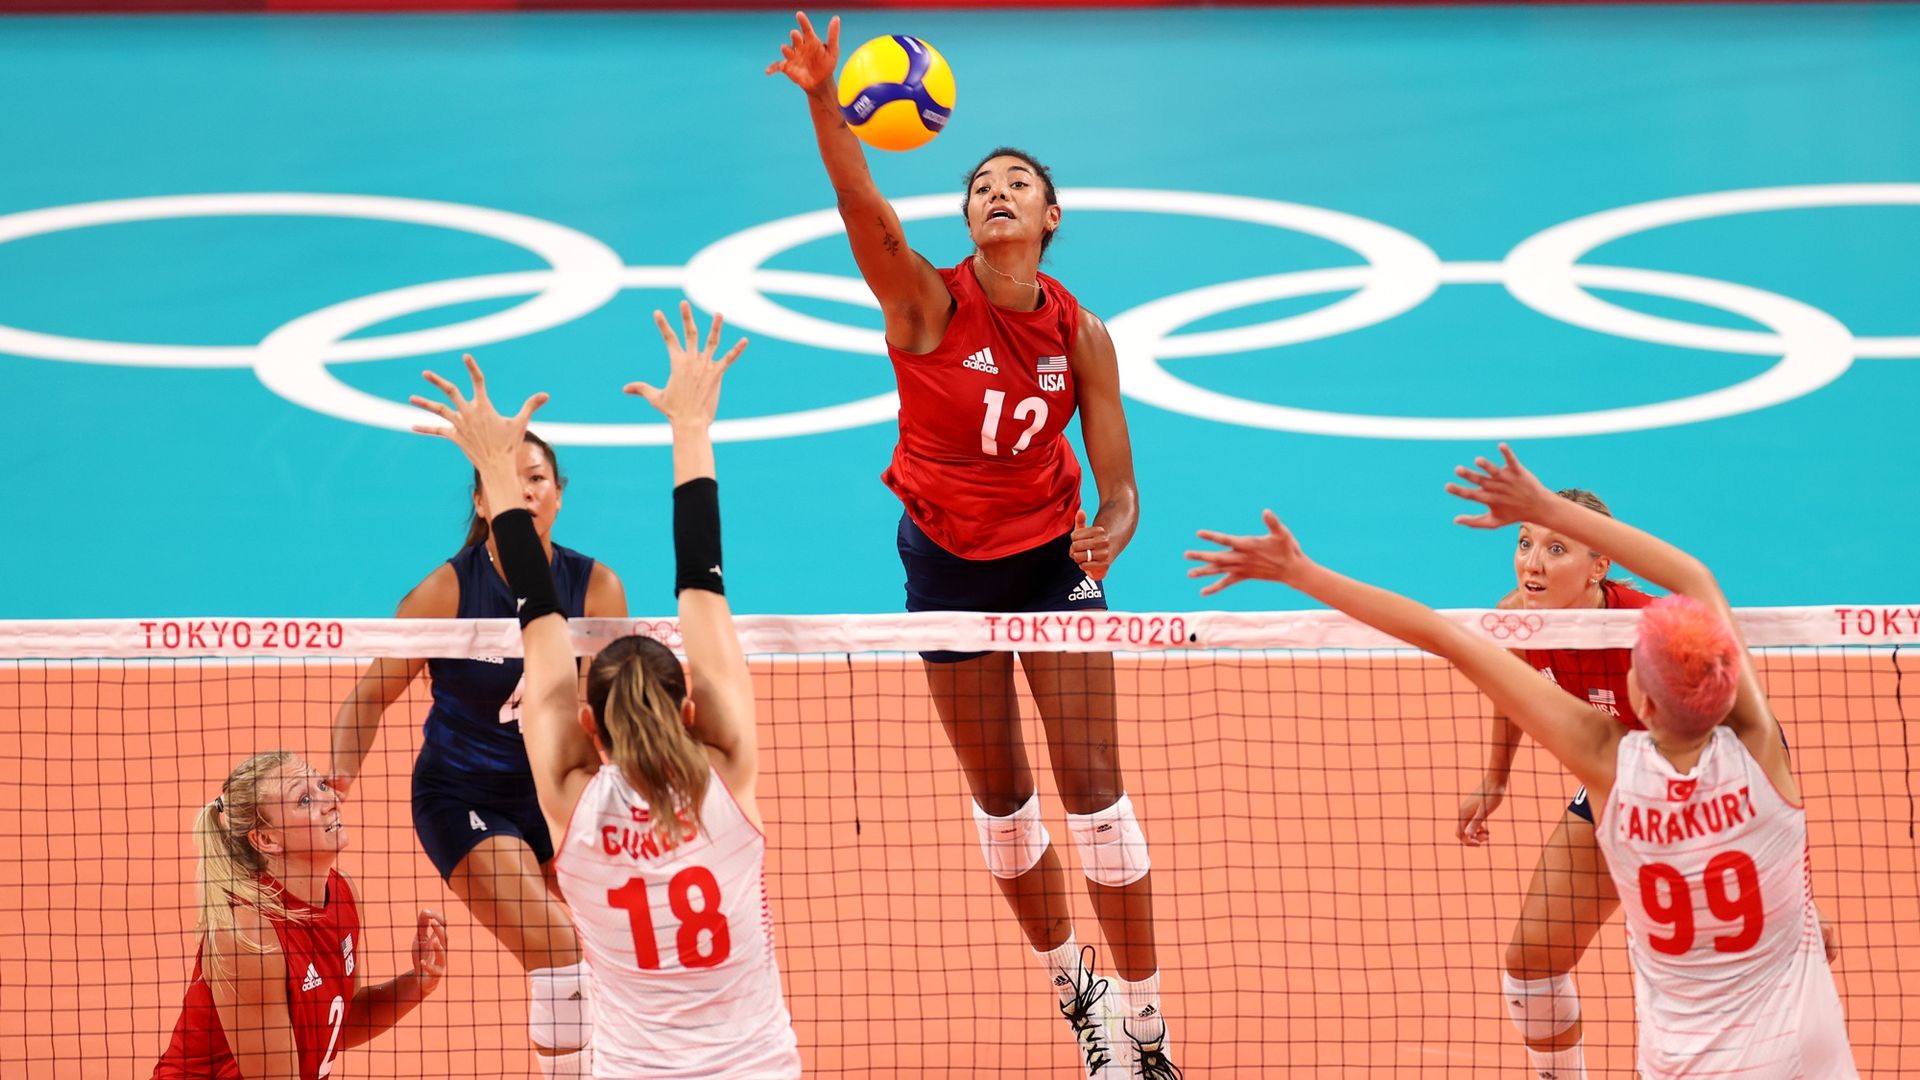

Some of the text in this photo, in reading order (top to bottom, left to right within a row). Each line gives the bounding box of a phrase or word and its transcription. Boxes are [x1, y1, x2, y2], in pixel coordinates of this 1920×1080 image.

[962, 359, 999, 375] adidas
[1038, 373, 1066, 392] USA
[981, 388, 1049, 456] 12
[1068, 589, 1102, 602] adida
[139, 622, 343, 649] TOKYO 2020
[985, 616, 1185, 645] TOKYO 2020
[468, 810, 488, 831] 4
[1618, 786, 1757, 845] ARAKURT
[1638, 850, 1765, 956] 99
[606, 866, 731, 971] 18
[318, 995, 345, 1080] 2
